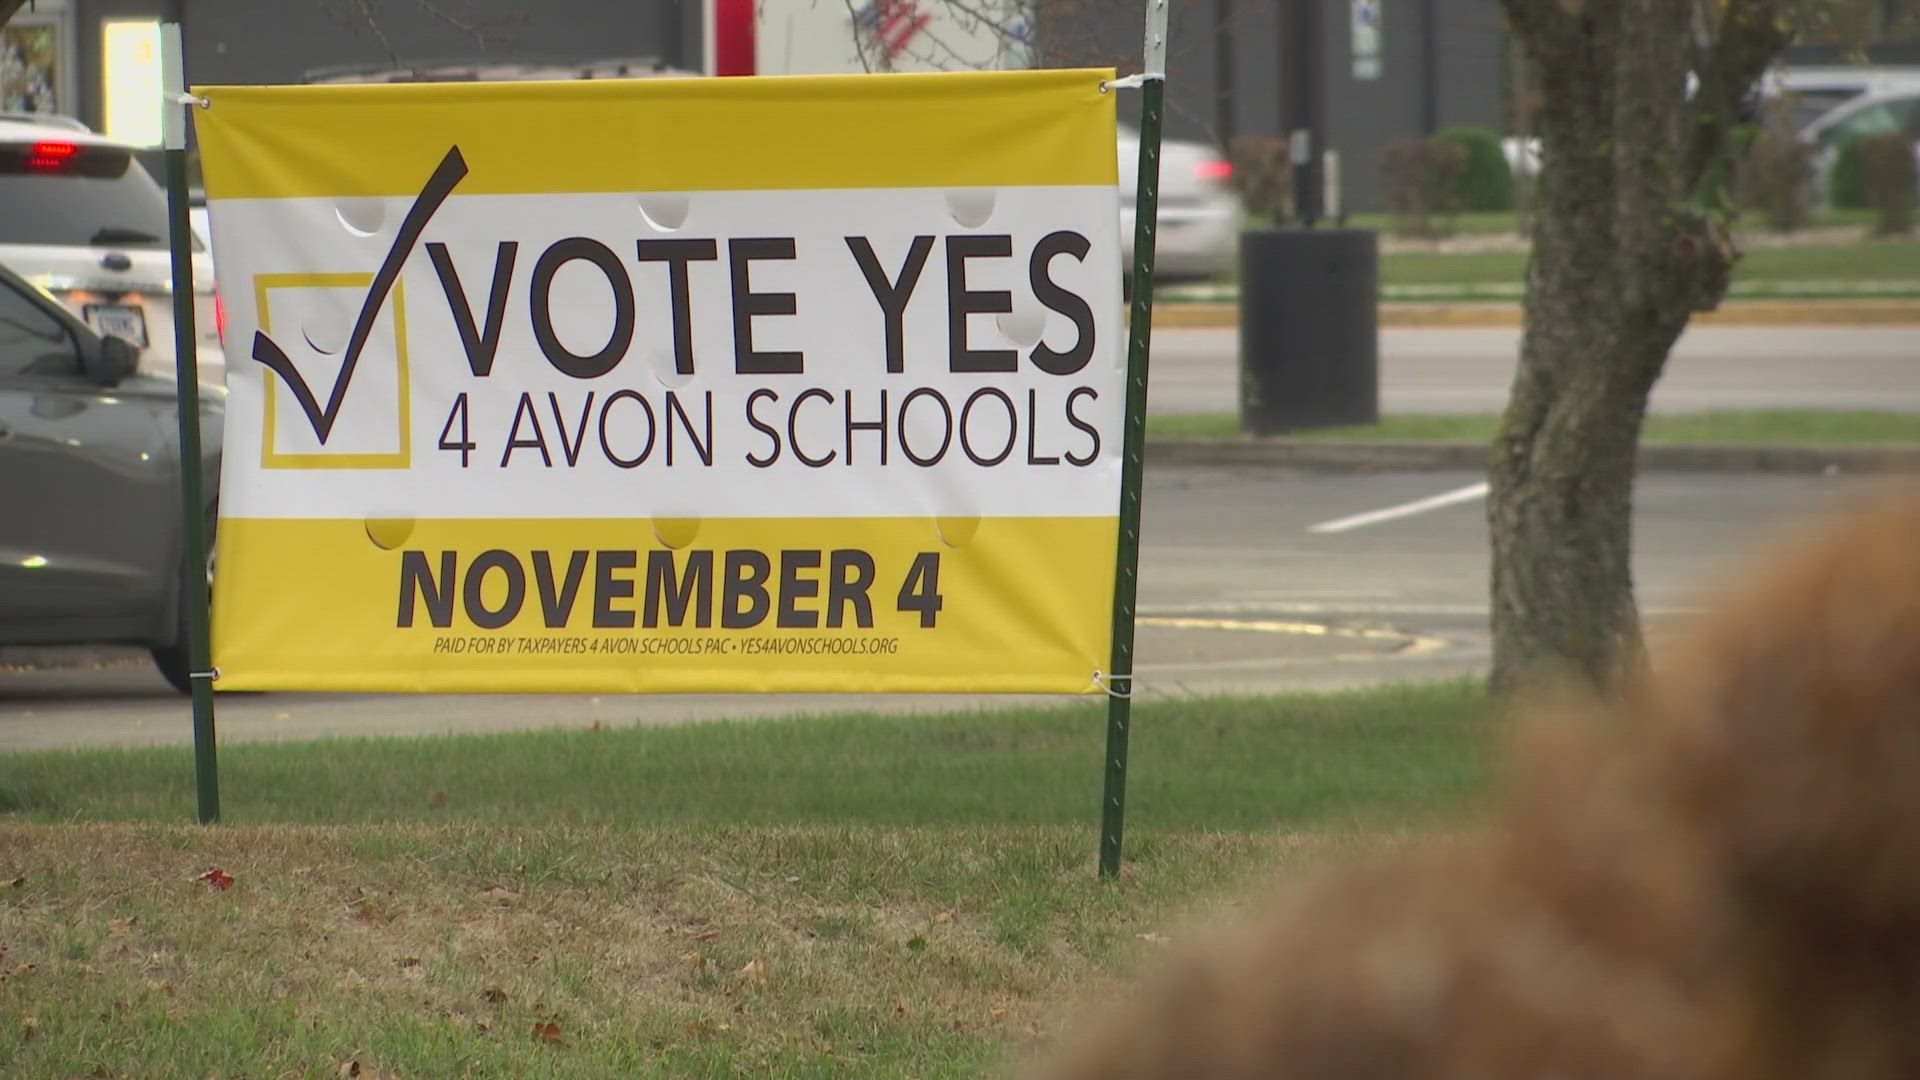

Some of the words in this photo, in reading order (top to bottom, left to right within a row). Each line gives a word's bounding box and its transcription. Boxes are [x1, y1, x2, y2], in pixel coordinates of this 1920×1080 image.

[426, 237, 804, 379] VOTE
[844, 230, 1096, 376] YES
[438, 392, 476, 468] 4
[501, 390, 713, 468] AVON
[745, 386, 1101, 468] SCHOOLS
[397, 549, 876, 629] NOVEMBER
[896, 552, 943, 628] 4
[433, 637, 466, 654] PAID
[468, 637, 494, 654] FOR
[496, 637, 515, 654] BY
[517, 637, 588, 654] TAXPAYERS
[589, 637, 599, 654] 4
[600, 637, 638, 654] AVON
[639, 637, 702, 654] SCHOOLS
[703, 637, 730, 654] PAC
[739, 637, 898, 654] YES4AVONSCHOOLS.ORG
